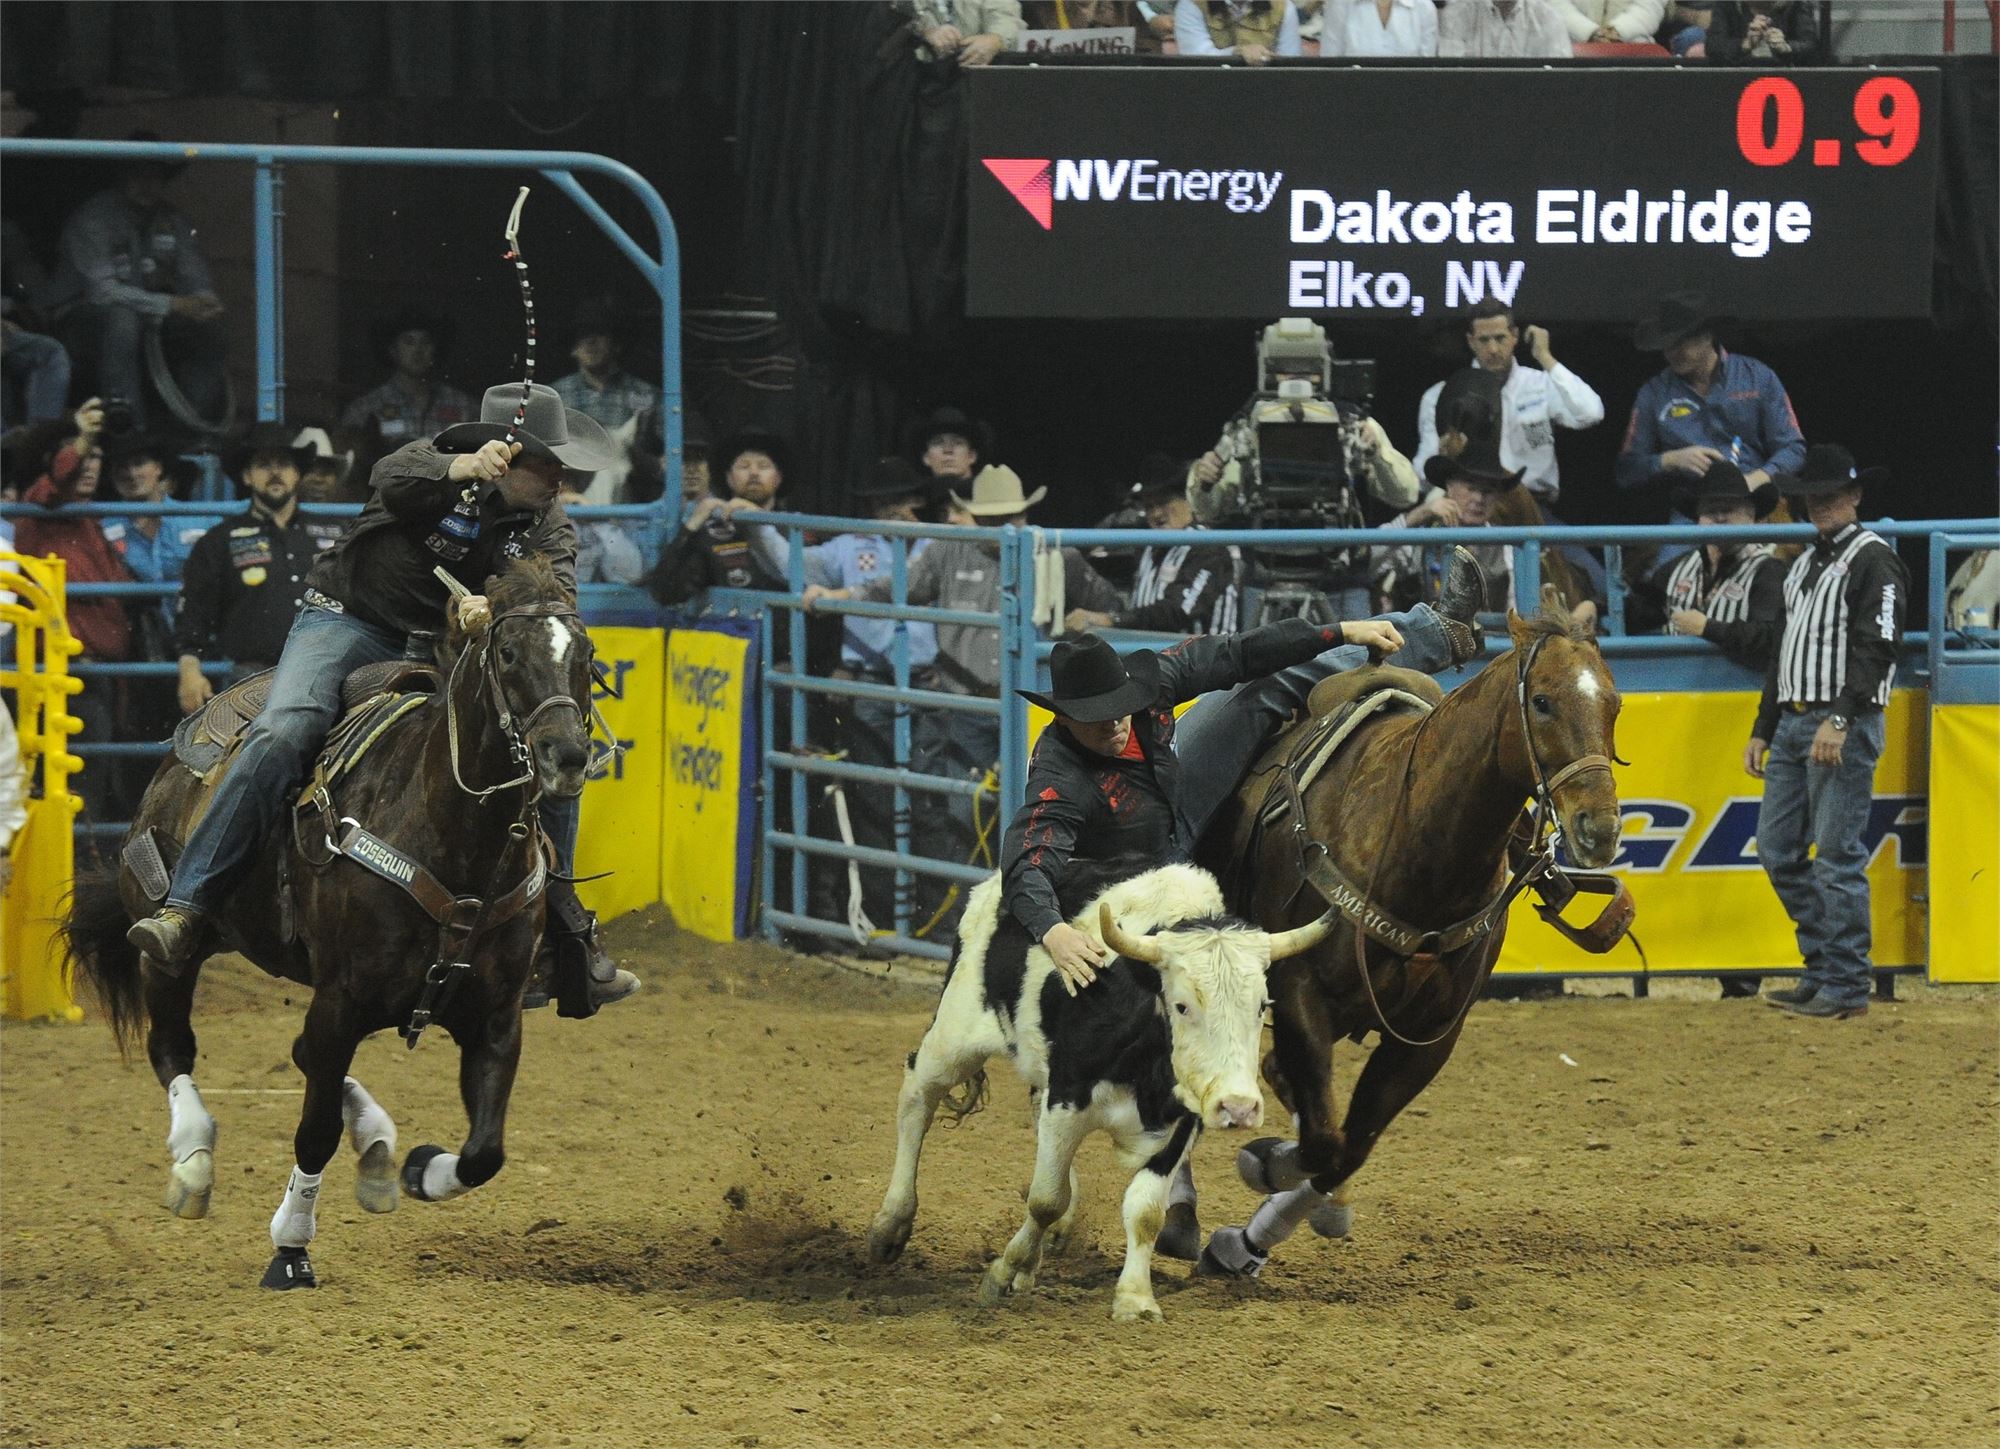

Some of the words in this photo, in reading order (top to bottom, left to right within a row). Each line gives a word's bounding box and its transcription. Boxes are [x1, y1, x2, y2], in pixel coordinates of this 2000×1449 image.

[1736, 76, 1921, 166] 0.9
[1290, 190, 1515, 243] Dakota
[1536, 190, 1812, 258] Eldridge
[1289, 260, 1425, 316] Elko,
[1445, 260, 1525, 308] NV
[354, 835, 417, 884] COSEQUIN
